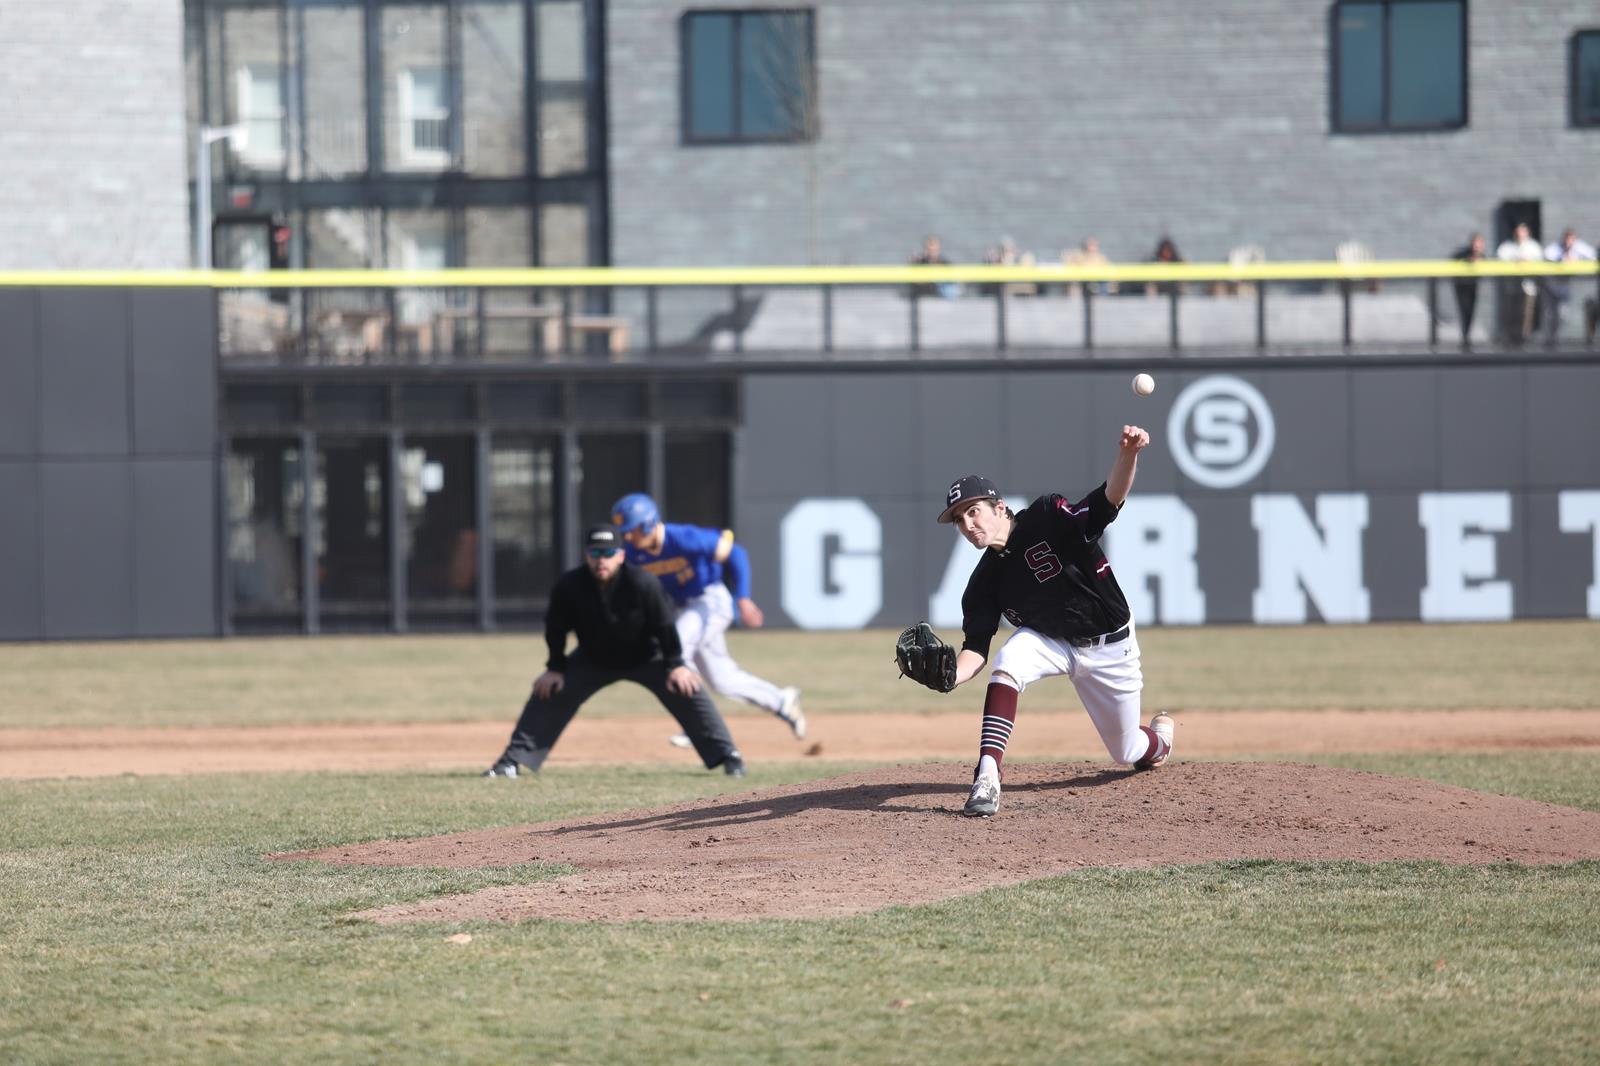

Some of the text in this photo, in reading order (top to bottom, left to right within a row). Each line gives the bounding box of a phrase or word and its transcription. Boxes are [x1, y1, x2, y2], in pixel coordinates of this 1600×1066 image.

[1193, 400, 1249, 464] S
[949, 483, 962, 504] S
[1024, 540, 1063, 584] S
